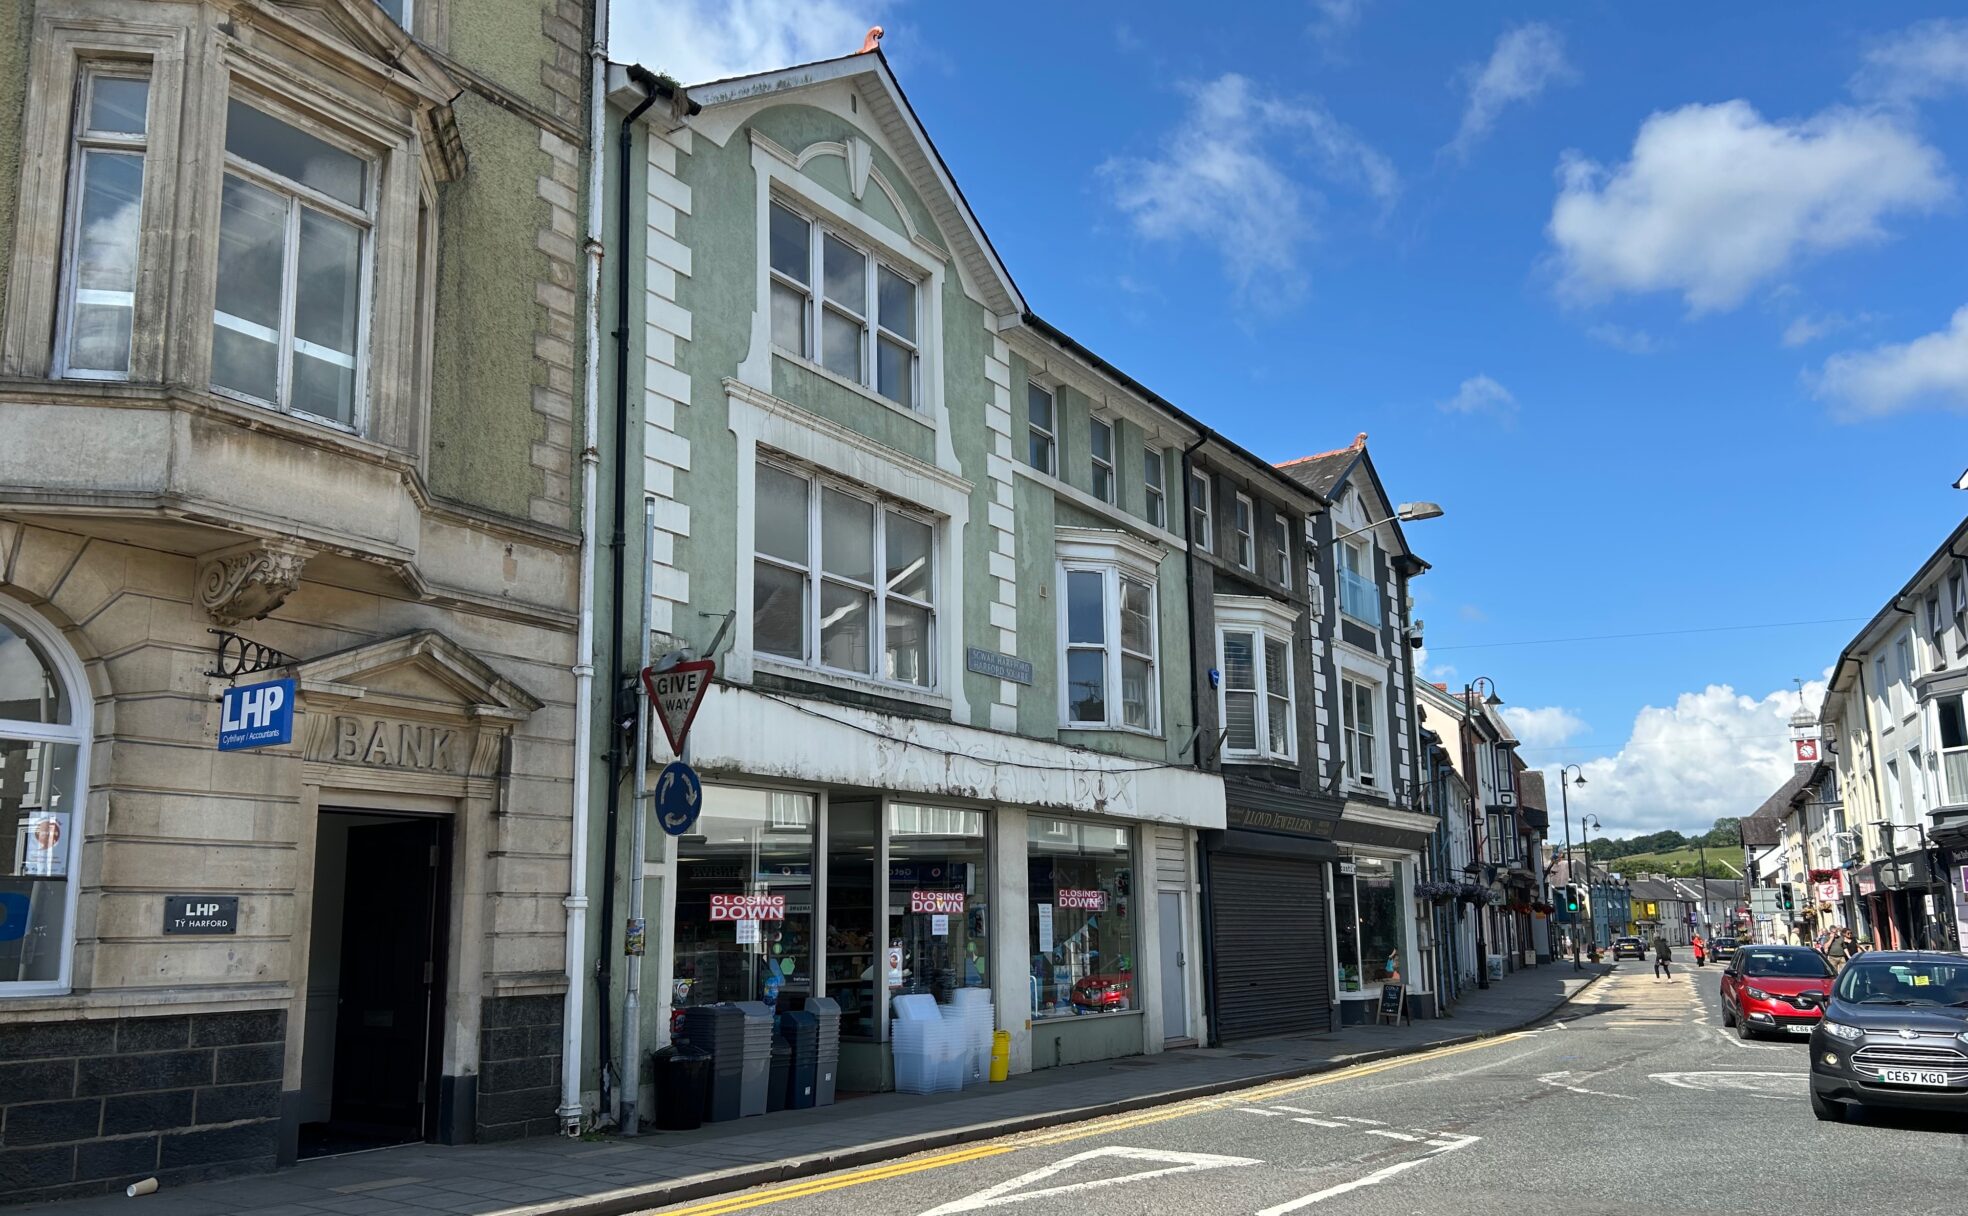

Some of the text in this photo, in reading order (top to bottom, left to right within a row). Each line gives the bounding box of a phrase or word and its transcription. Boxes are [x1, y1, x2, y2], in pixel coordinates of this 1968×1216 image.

[657, 674, 697, 695] GIVE
[221, 686, 284, 732] LHP
[666, 698, 690, 711] WAY
[249, 729, 280, 740] Accountants
[332, 716, 458, 772] BANK
[912, 891, 964, 900] CLOSING
[1059, 889, 1098, 898] CLOSING
[712, 896, 784, 905] CLOSING
[911, 900, 964, 912] DOWN
[1059, 898, 1098, 907] DOWN
[185, 903, 220, 916] LHP
[711, 906, 784, 919] DOWN
[188, 919, 228, 927] HARFORD
[1886, 1071, 1945, 1084] CE67 KGO
